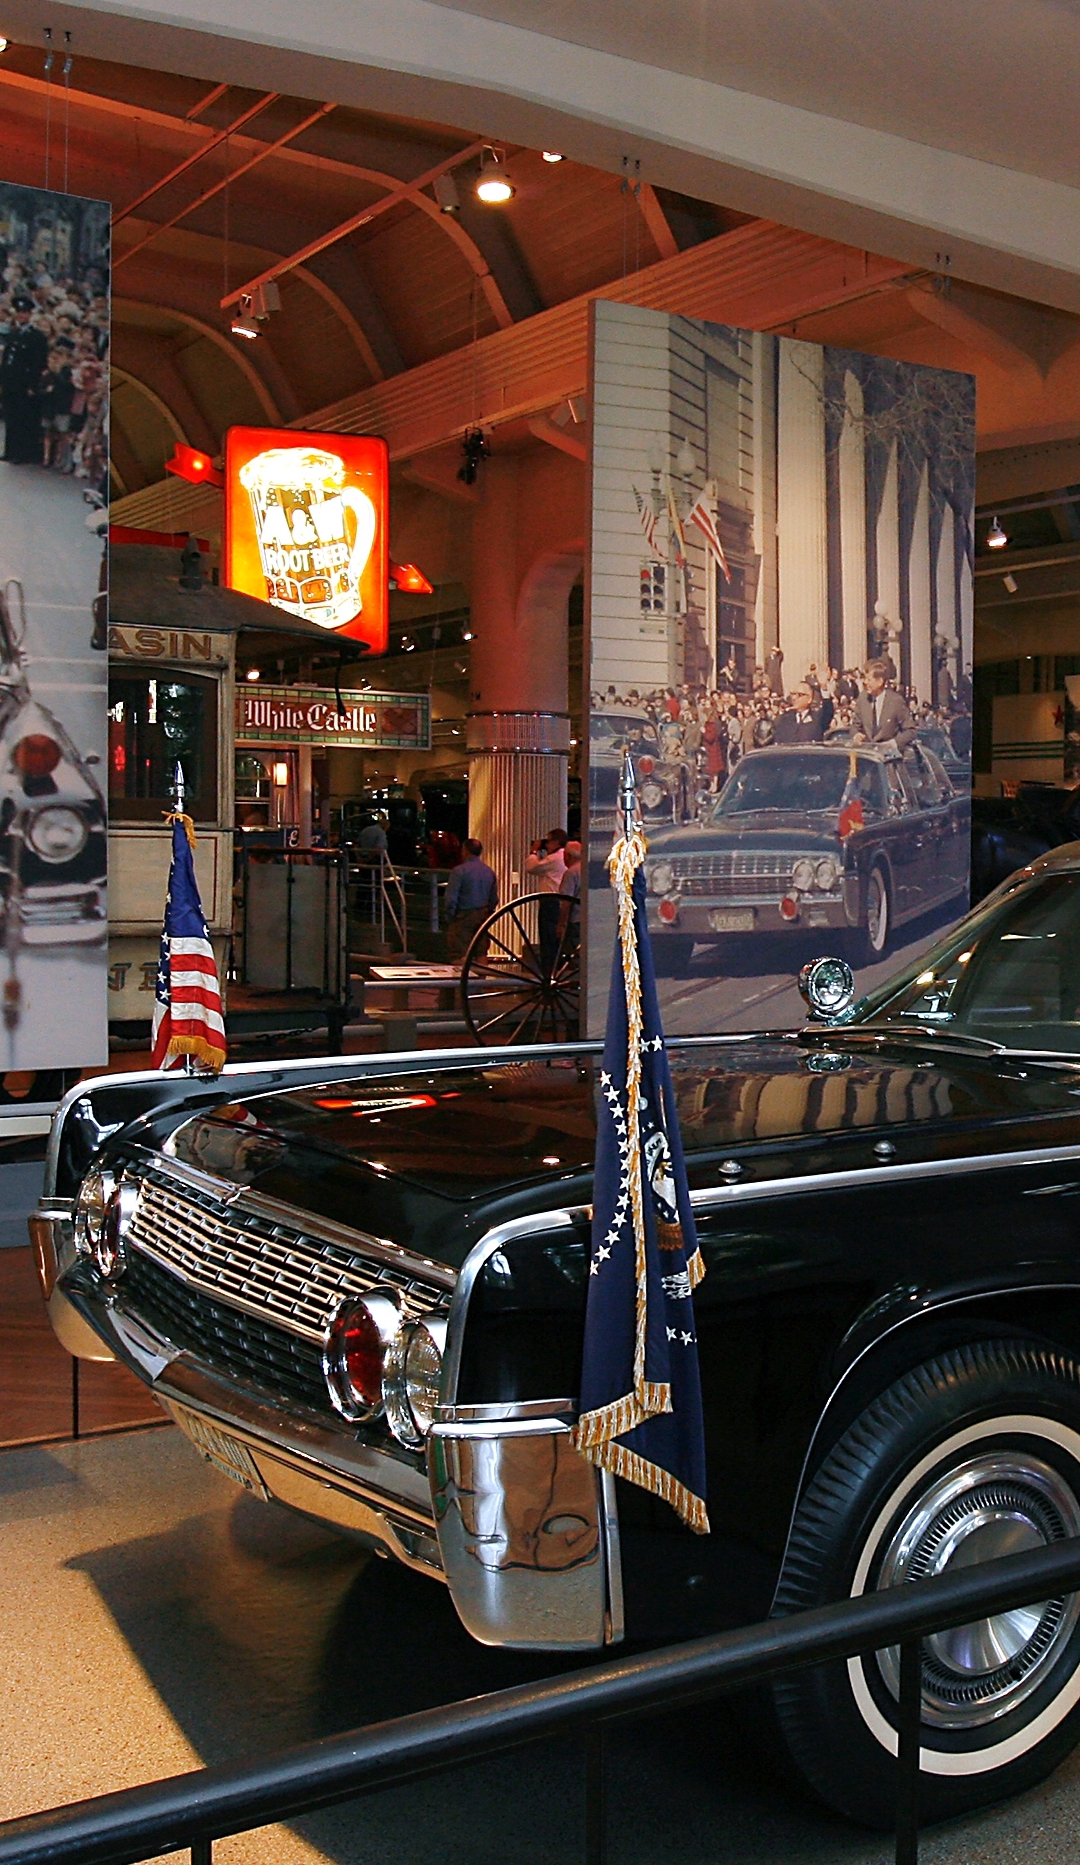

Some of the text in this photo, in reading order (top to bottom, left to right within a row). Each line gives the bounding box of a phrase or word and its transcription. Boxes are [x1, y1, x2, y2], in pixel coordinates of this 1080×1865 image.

[265, 542, 352, 573] ROOT BEER
[245, 700, 377, 732] White Castle
